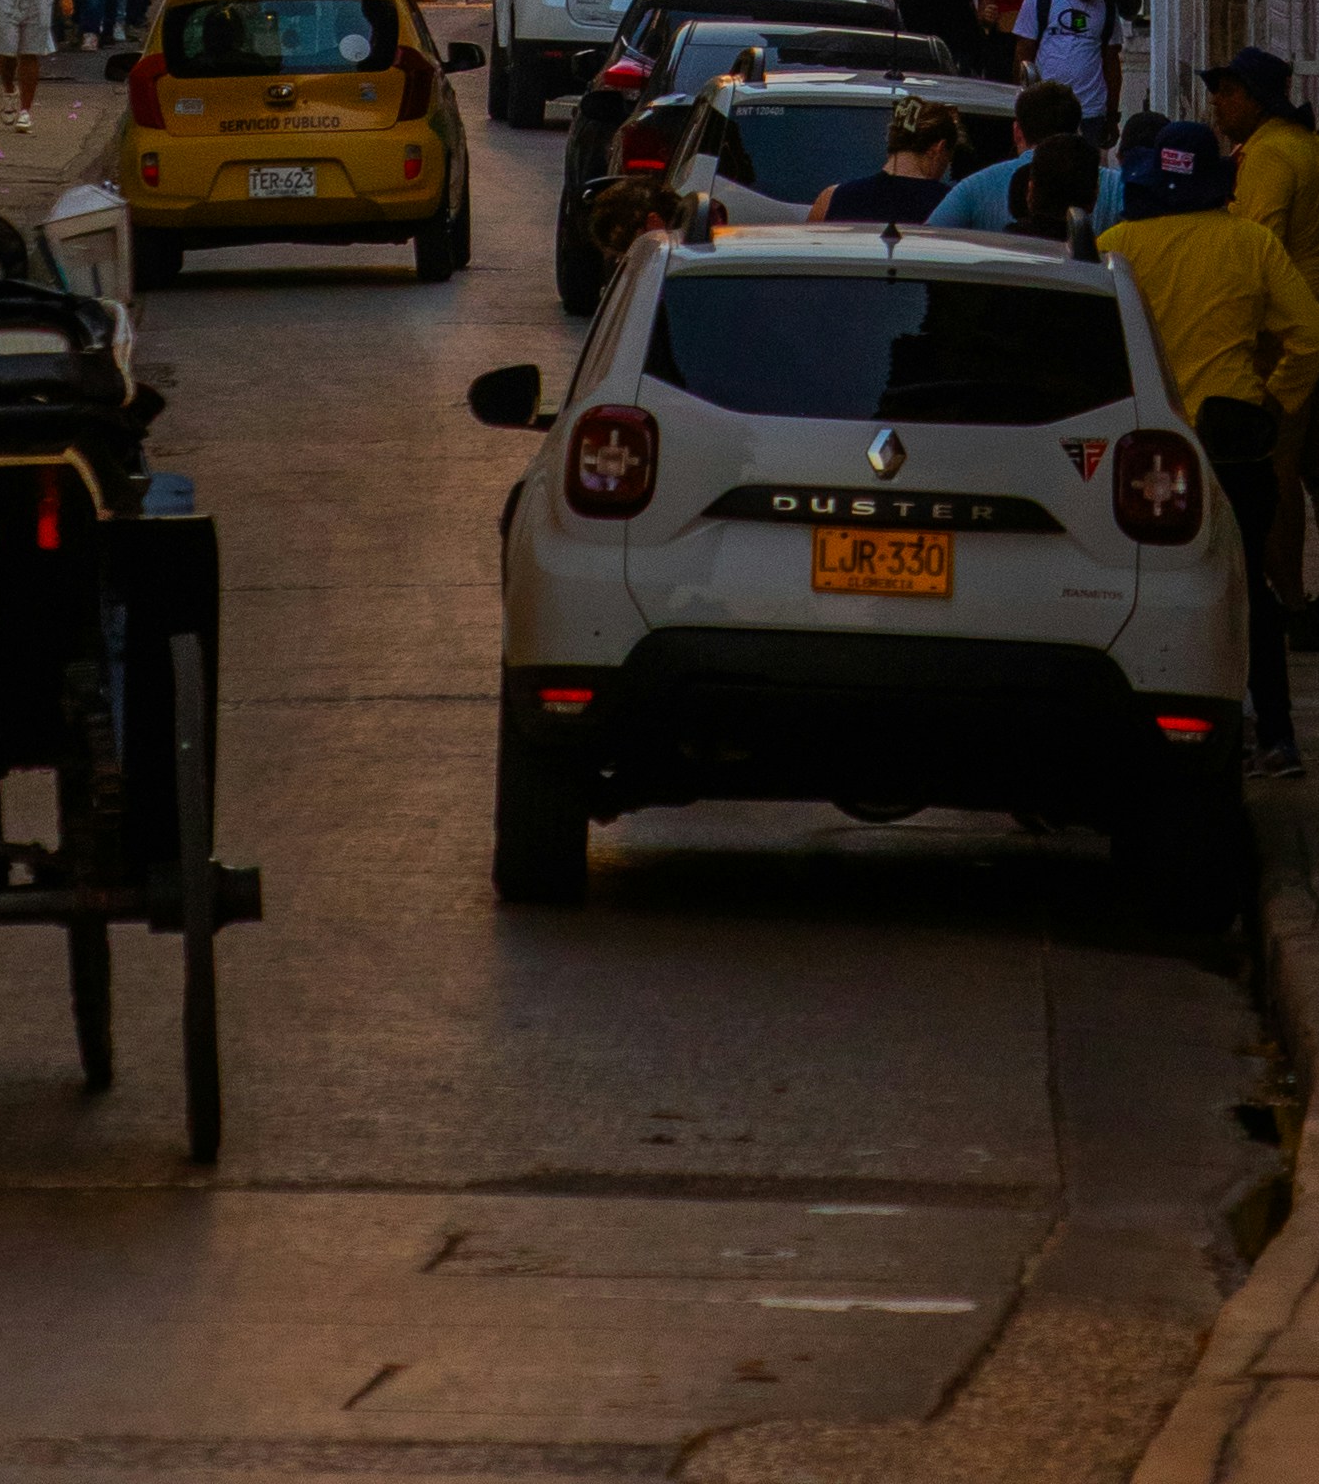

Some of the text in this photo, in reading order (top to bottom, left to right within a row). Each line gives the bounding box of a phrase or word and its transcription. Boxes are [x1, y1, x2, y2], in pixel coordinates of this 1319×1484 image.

[219, 116, 341, 132] SERVICIO PUBLICO
[772, 495, 994, 521] DUSTER
